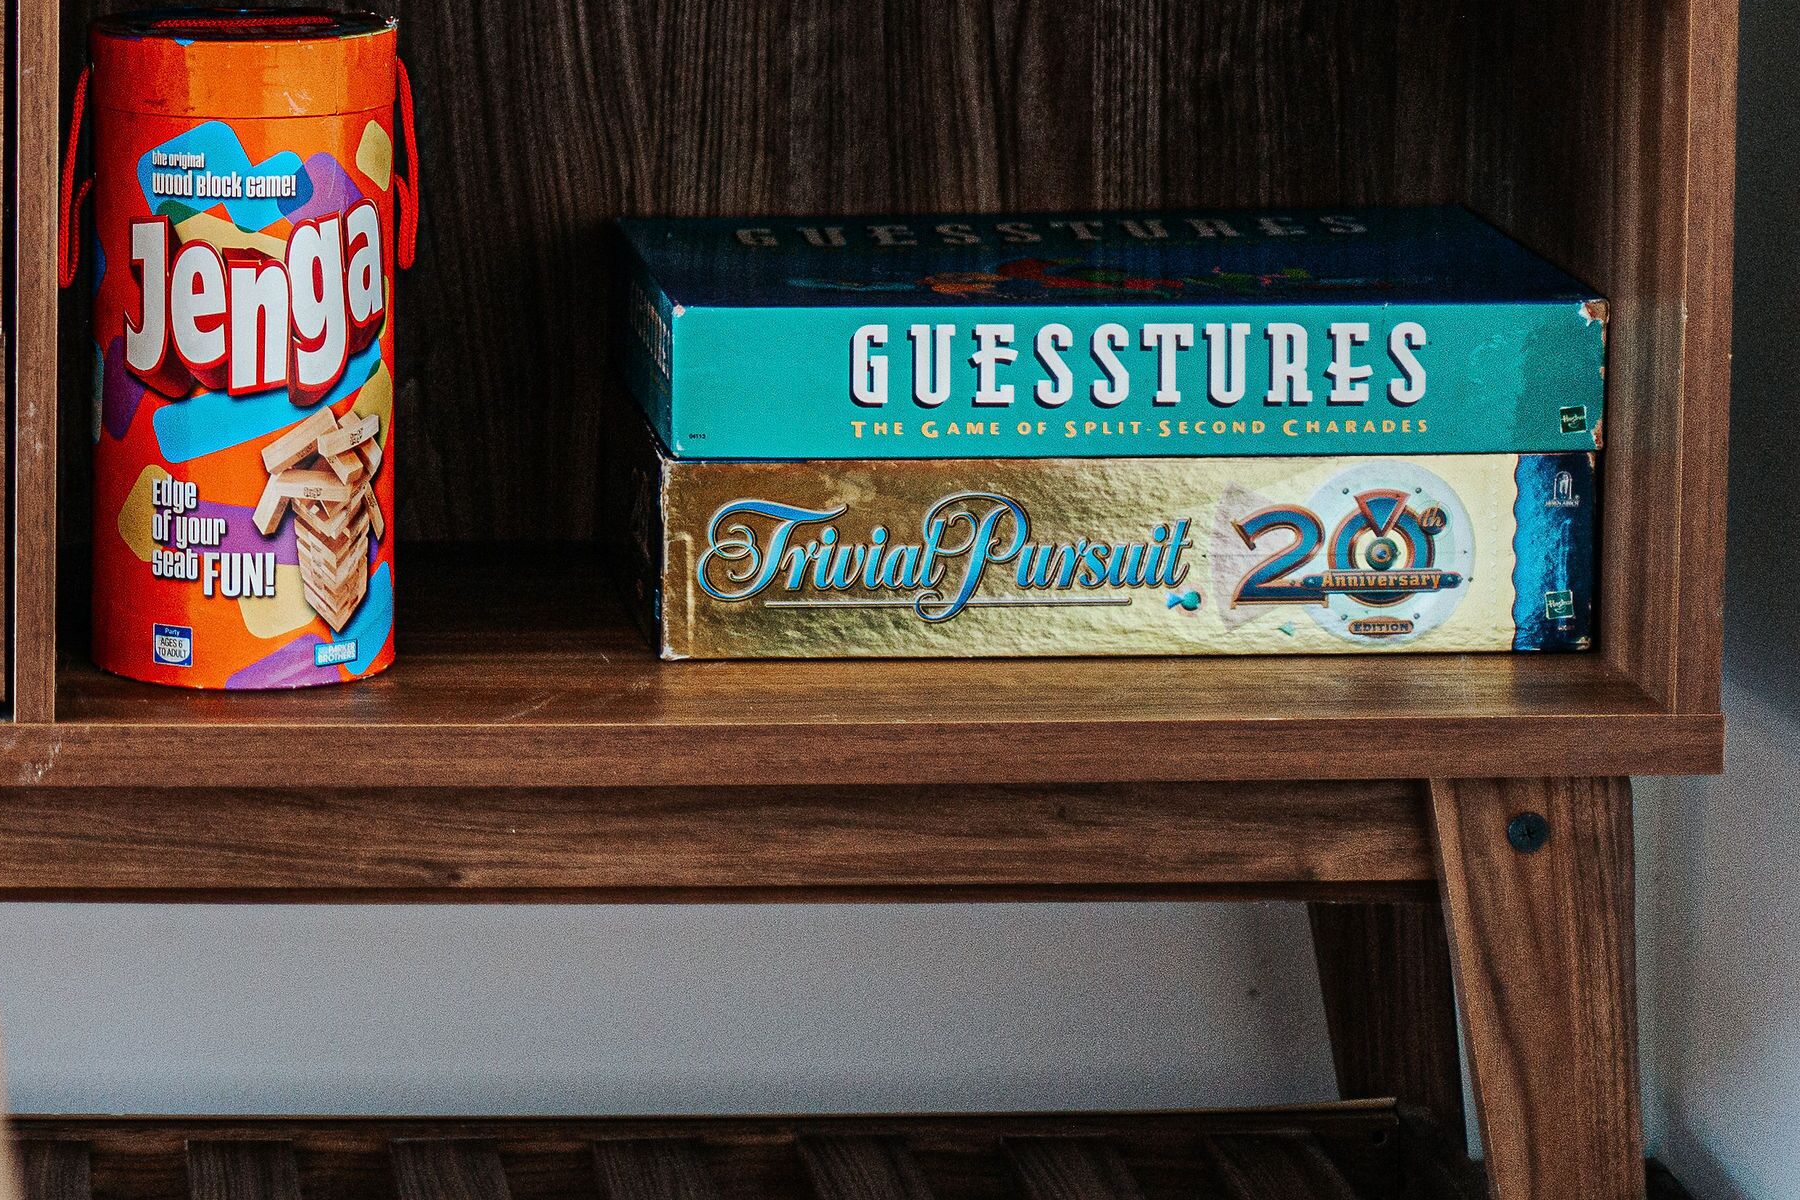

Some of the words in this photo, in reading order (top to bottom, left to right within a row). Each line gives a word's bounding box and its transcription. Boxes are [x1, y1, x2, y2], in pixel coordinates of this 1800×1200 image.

[151, 150, 168, 168] the
[167, 152, 205, 170] original
[152, 171, 193, 196] wood
[736, 213, 1368, 249] GUESSTURES
[124, 200, 384, 392] Jenga
[850, 322, 1428, 407] GUESSTURES
[850, 420, 905, 439] THE
[921, 420, 1001, 439] GAME
[1016, 421, 1047, 437] OF
[1064, 419, 1266, 438] SPLIT-SECOND
[1283, 418, 1429, 437] CHARADES
[151, 475, 198, 511] Edge
[151, 513, 172, 542] of
[175, 517, 226, 549] your
[698, 497, 947, 603] Trivial
[915, 491, 1193, 624] Pursuit
[151, 549, 199, 580] seat
[203, 552, 276, 597] FUN!
[1321, 569, 1442, 591] Anniversary
[164, 627, 180, 636] Party
[1352, 620, 1413, 634] EDITION
[158, 646, 169, 656] TO
[169, 647, 187, 659] ADULT
[160, 637, 178, 647] AGES
[328, 641, 356, 653] PARKER
[318, 650, 356, 664] BROTHERS
